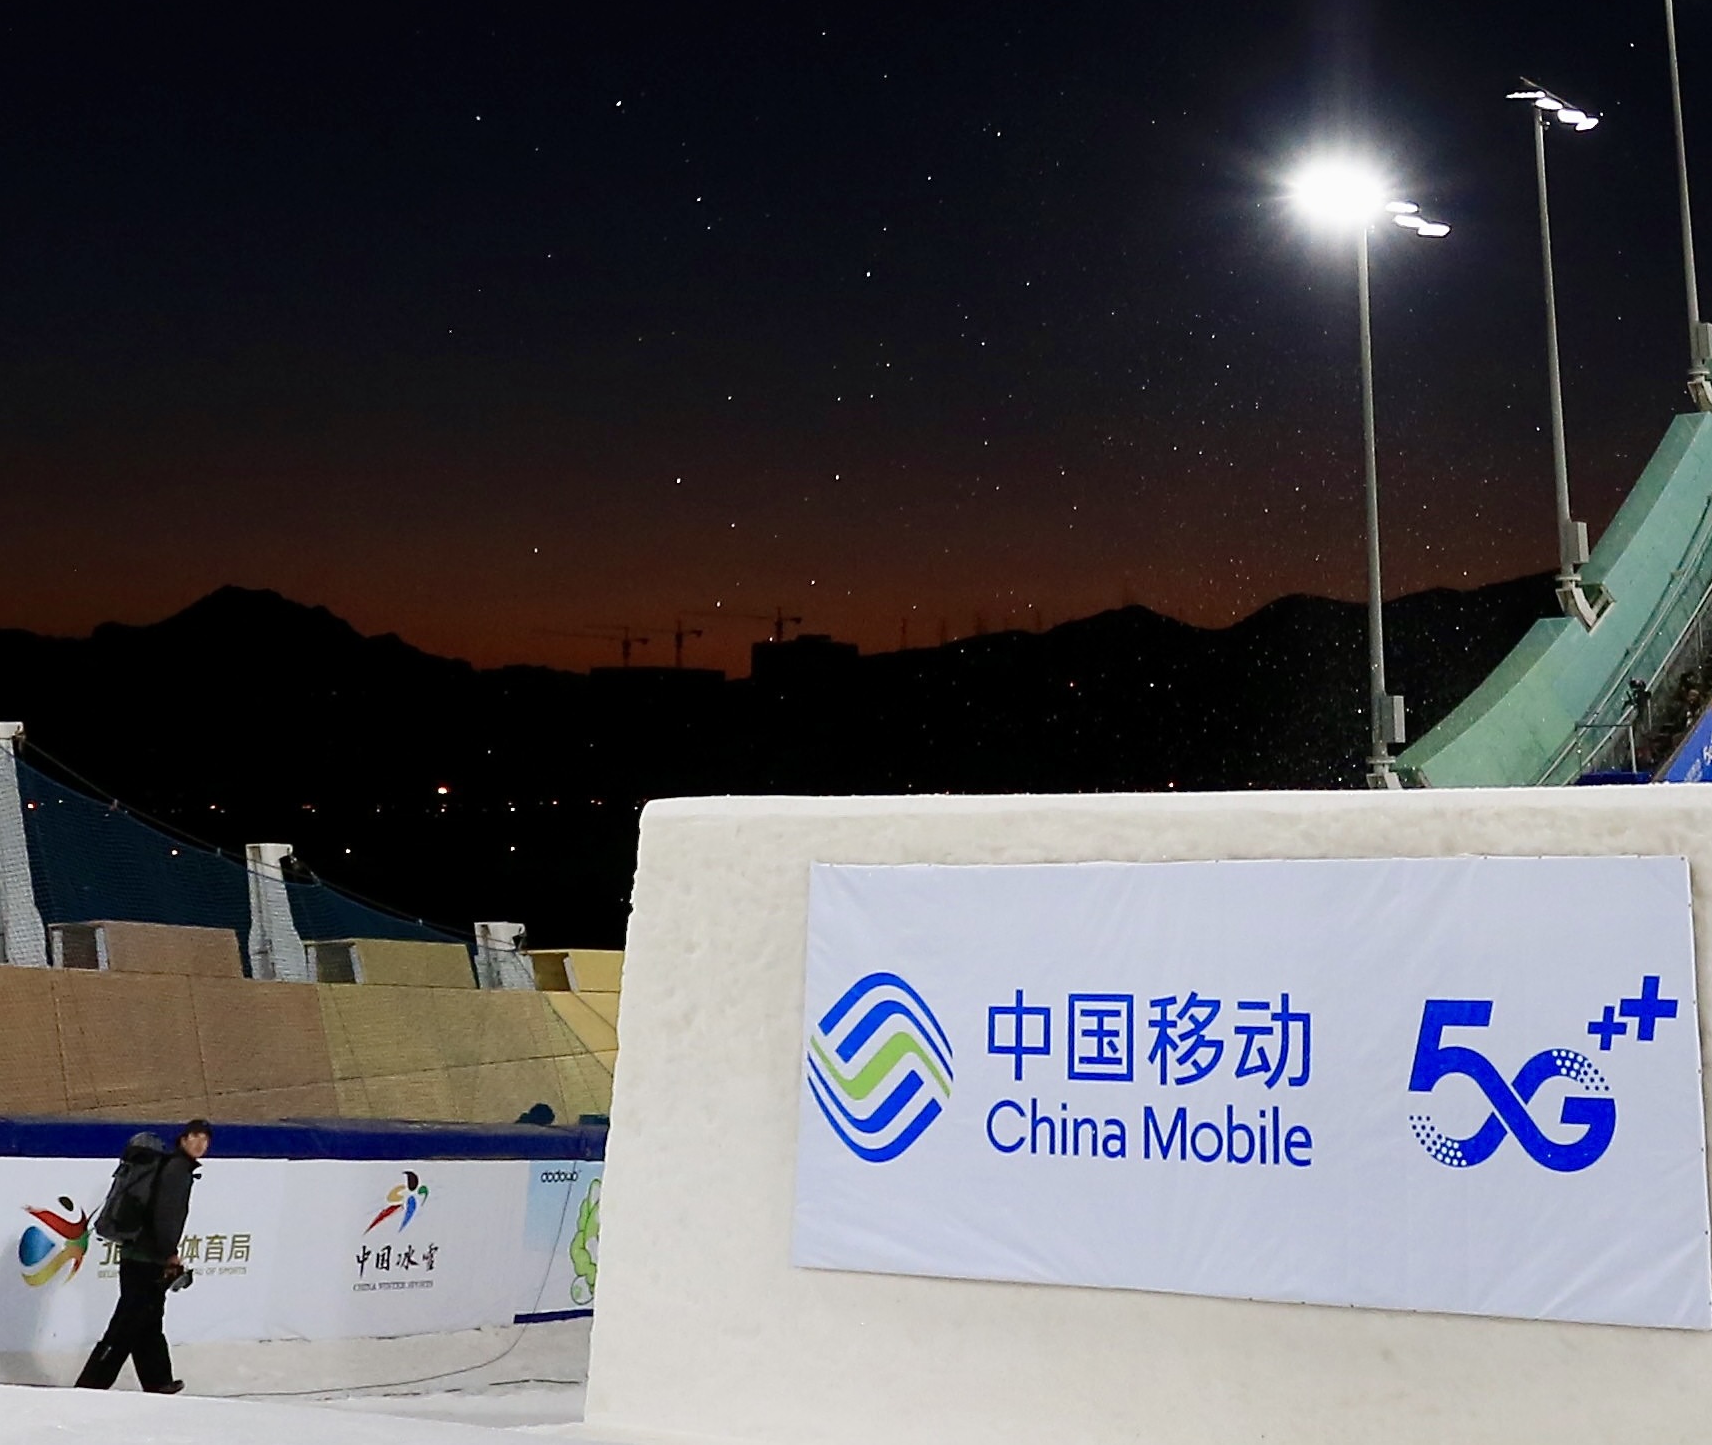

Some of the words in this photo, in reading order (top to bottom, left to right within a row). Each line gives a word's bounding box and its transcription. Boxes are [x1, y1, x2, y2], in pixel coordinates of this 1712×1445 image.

[986, 990, 1311, 1088] 中国移动
[986, 1100, 1128, 1159] China
[1143, 1105, 1314, 1167] Mobile
[99, 1234, 251, 1266] 北体育局
[356, 1243, 439, 1279] 中国冰雪
